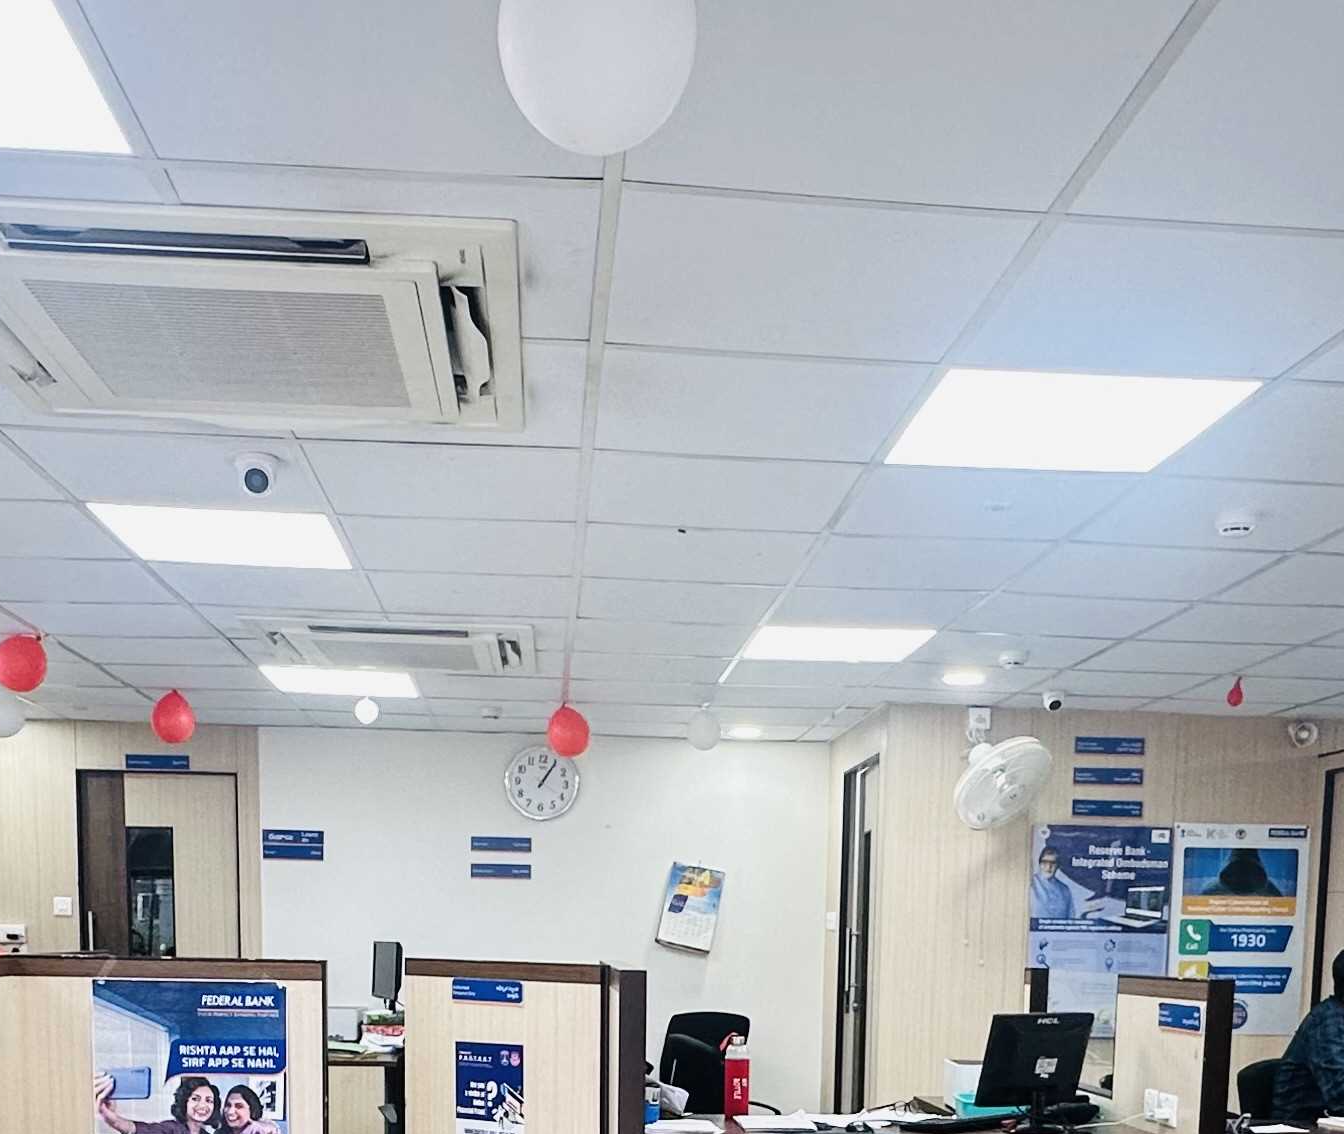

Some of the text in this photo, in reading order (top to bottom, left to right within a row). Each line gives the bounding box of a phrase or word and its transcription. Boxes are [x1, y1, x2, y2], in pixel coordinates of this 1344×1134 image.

[518, 764, 527, 774] 10
[560, 767, 567, 777] 2
[562, 780, 569, 790] 3
[526, 798, 532, 808] 7
[1230, 933, 1266, 948] 1930
[201, 994, 275, 1007] FEDERAL BANK
[1037, 1017, 1060, 1025] HCL
[179, 1045, 217, 1057] RISHTA
[219, 1045, 241, 1057] AAP
[243, 1045, 256, 1057] SE
[182, 1057, 205, 1068] SIRF
[207, 1057, 230, 1068] APP
[231, 1058, 244, 1068] SE
